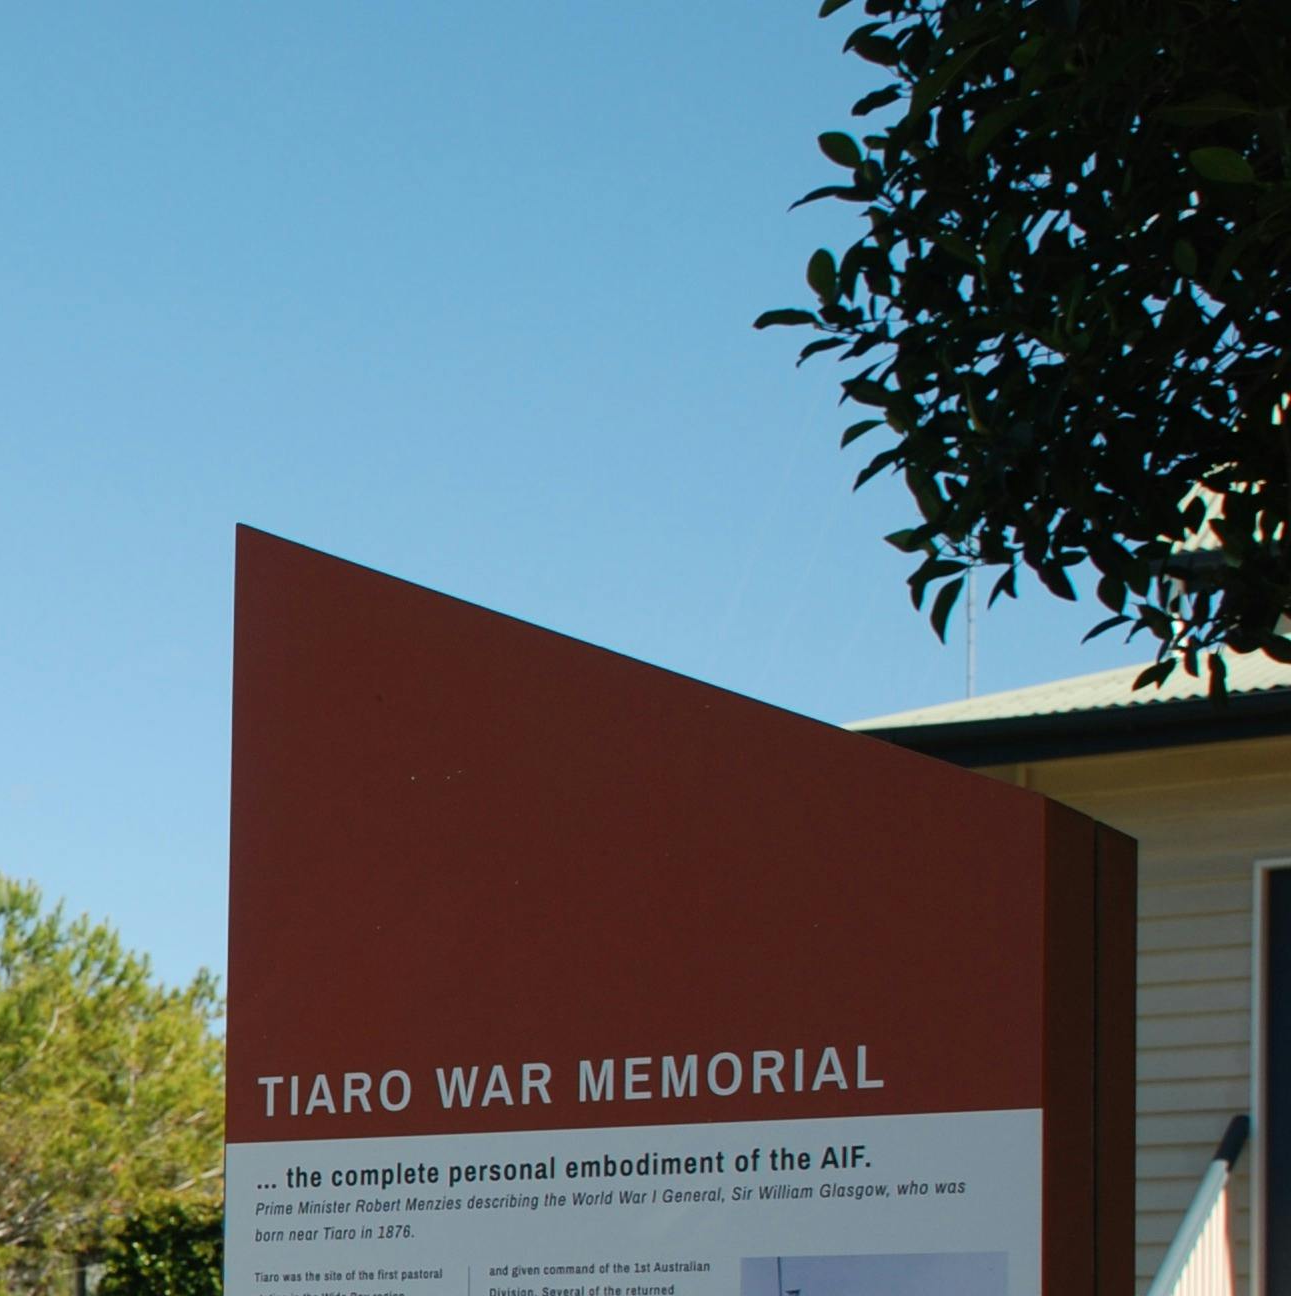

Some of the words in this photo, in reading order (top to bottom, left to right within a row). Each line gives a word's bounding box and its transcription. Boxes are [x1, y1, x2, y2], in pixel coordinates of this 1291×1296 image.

[257, 1070, 411, 1115] TIARO
[435, 1063, 551, 1107] WAR
[579, 1044, 884, 1100] MEMORIAL
[286, 1166, 321, 1188] the
[331, 1163, 438, 1187] complete
[449, 1157, 554, 1185] personal
[565, 1152, 724, 1177] embodiment
[734, 1148, 760, 1172] of
[769, 1148, 810, 1170] the
[820, 1145, 871, 1168] AIF.
[255, 1201, 292, 1215] Prime
[297, 1200, 351, 1213] Minister
[355, 1198, 400, 1212] Robert
[405, 1196, 461, 1210] Menzies
[467, 1194, 539, 1209] describing
[544, 1192, 566, 1206] the
[572, 1190, 613, 1205] World
[619, 1190, 647, 1204] War
[651, 1189, 656, 1203] I
[662, 1187, 726, 1203] General,
[731, 1186, 753, 1200] Sir
[758, 1184, 813, 1199] William
[819, 1183, 891, 1199] Glasgow,
[897, 1180, 928, 1195] who
[934, 1181, 966, 1194] was
[254, 1228, 284, 1242] born
[288, 1229, 318, 1240] near
[323, 1226, 356, 1239] Tiaro
[360, 1225, 372, 1238] in
[377, 1224, 415, 1238] 1876.
[254, 1272, 279, 1282] Tiaro
[282, 1273, 301, 1281] was
[304, 1271, 320, 1281] the
[323, 1270, 342, 1281] site
[345, 1270, 355, 1280] of
[358, 1270, 374, 1280] the
[377, 1269, 398, 1279] first
[400, 1268, 442, 1281] pastoral
[488, 1265, 508, 1276] and
[511, 1265, 539, 1277] given
[543, 1263, 594, 1274] command
[598, 1262, 609, 1274] of
[612, 1262, 630, 1273] the
[633, 1262, 650, 1273] 1st
[653, 1261, 710, 1272] Australian
[541, 1286, 584, 1296] Several
[588, 1285, 599, 1296] of
[603, 1285, 621, 1296] the
[625, 1284, 674, 1295] returned
